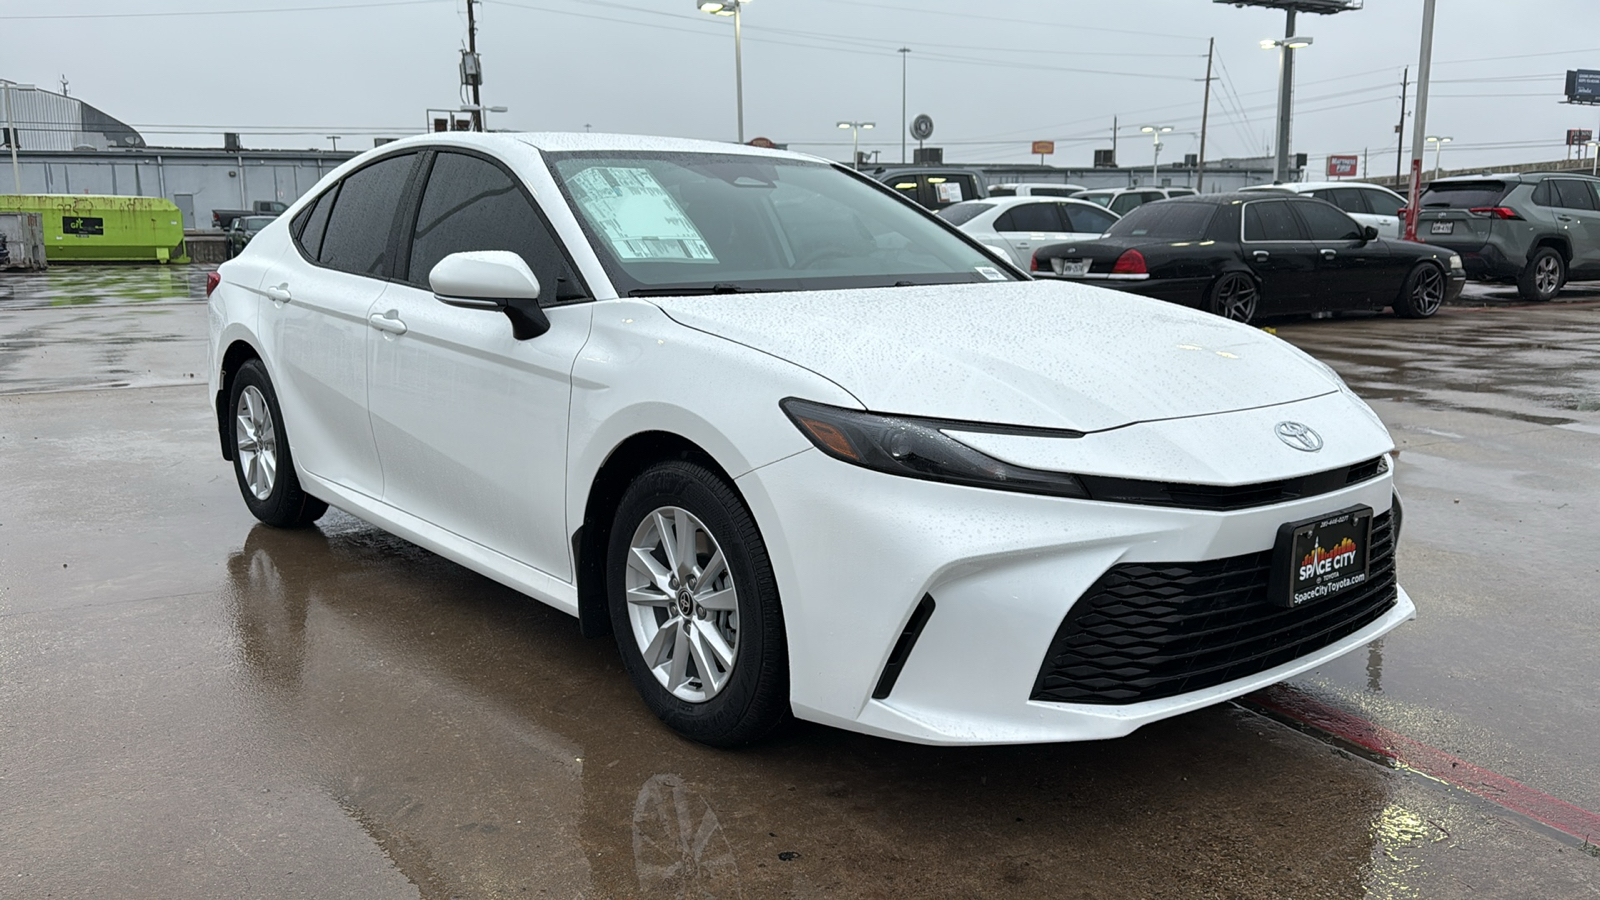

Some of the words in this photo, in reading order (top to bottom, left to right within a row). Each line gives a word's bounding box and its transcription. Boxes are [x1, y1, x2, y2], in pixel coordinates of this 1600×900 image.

[1299, 557, 1332, 580] SPACE
[1333, 550, 1356, 570] CITY
[1323, 572, 1340, 582] TOYOTA
[1294, 573, 1365, 604] SpaceCityToyota.com
